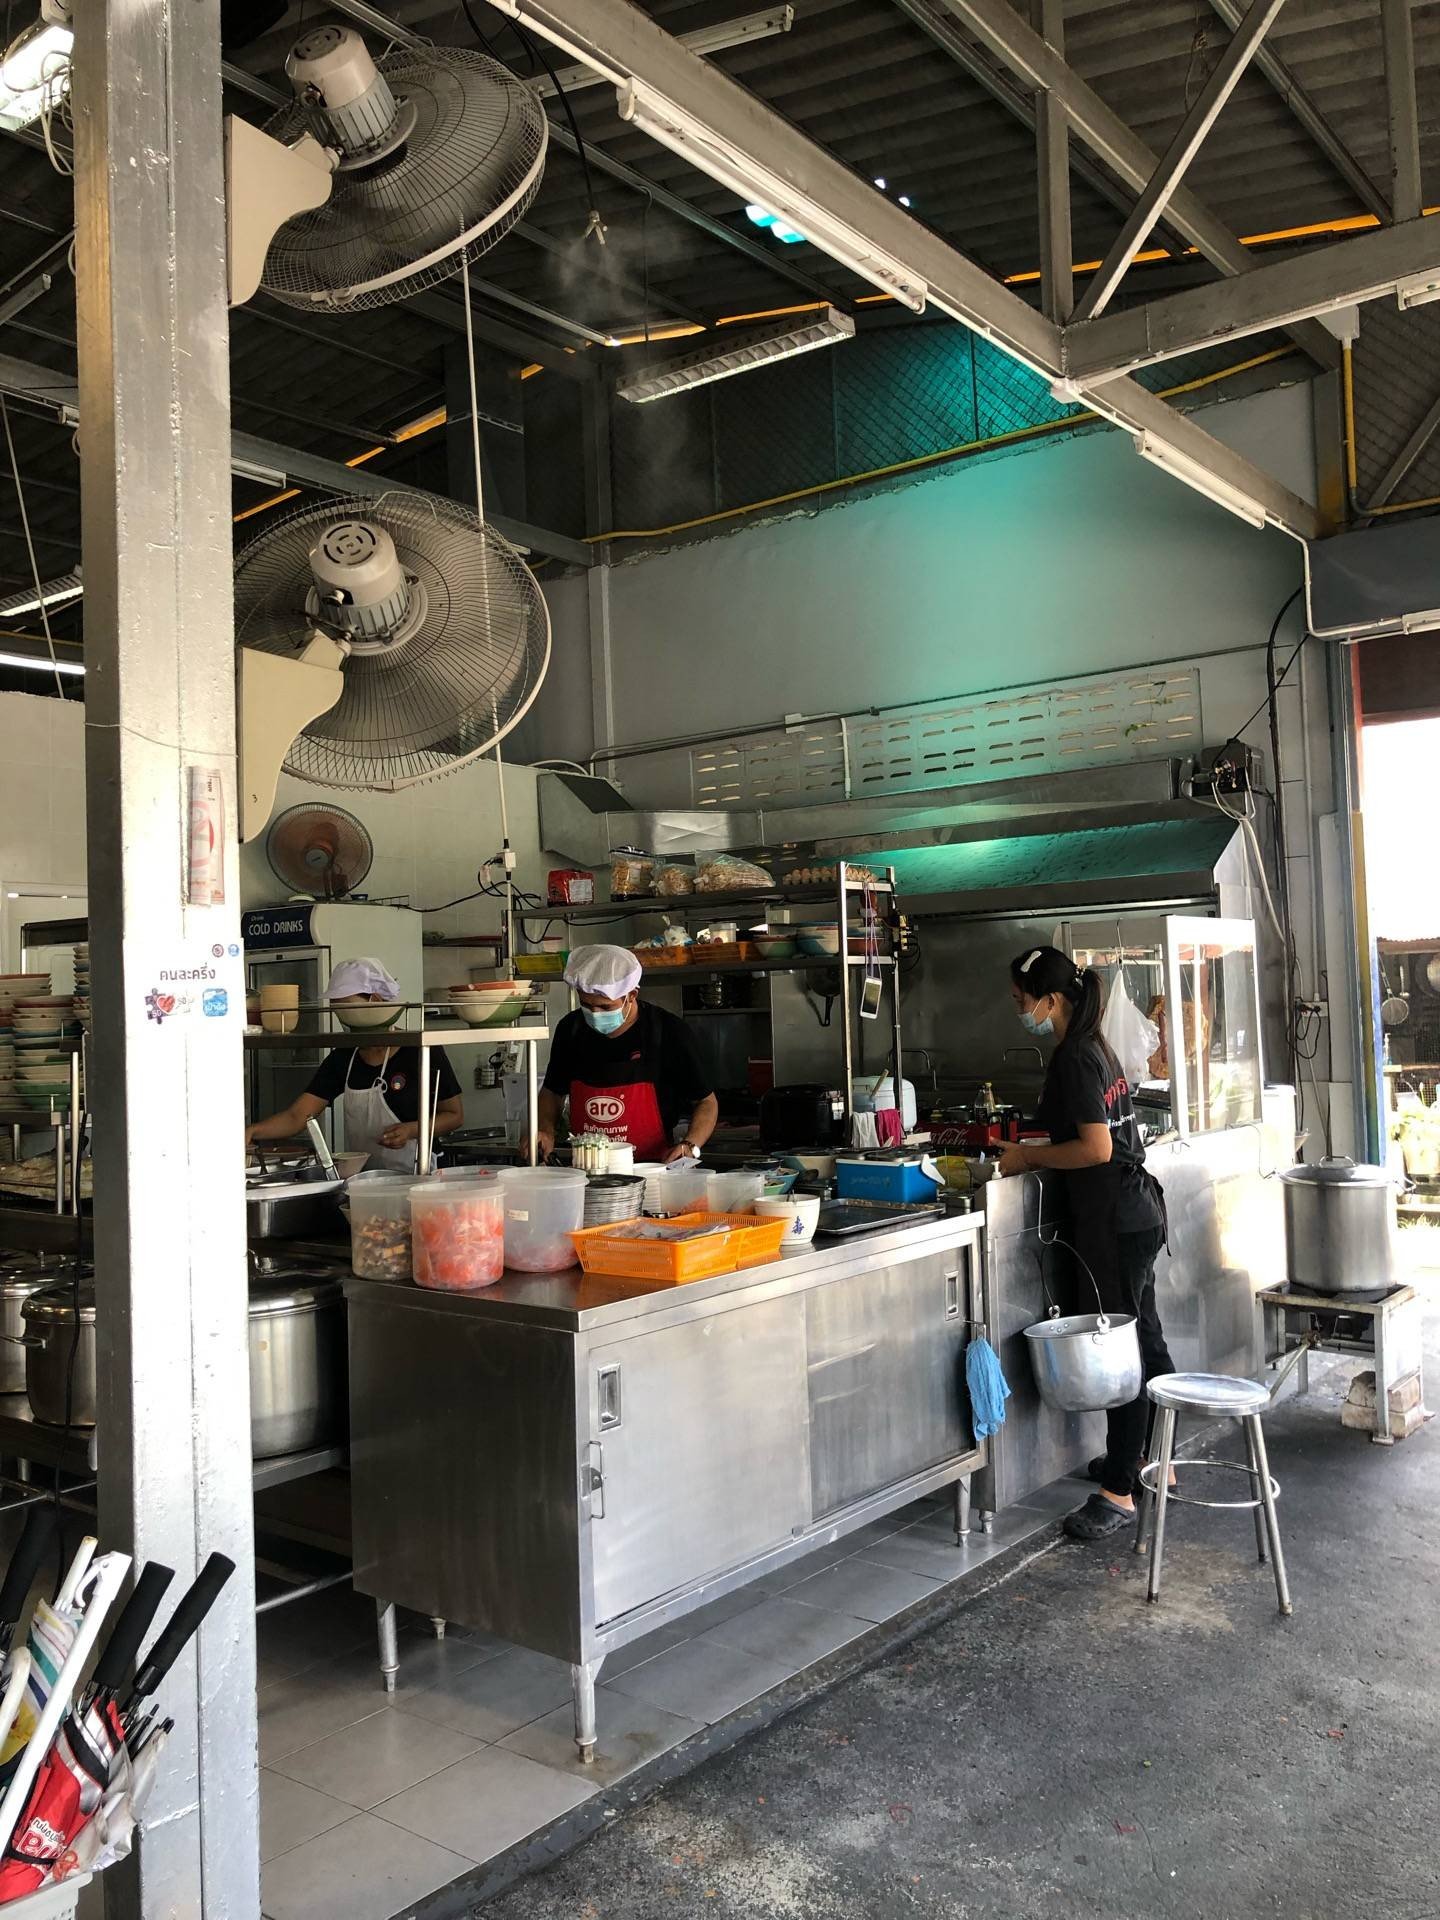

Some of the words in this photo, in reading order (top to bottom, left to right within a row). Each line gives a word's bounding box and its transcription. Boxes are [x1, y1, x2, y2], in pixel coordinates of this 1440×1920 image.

[248, 923, 270, 935] COLD
[273, 920, 303, 933] DRINKS
[160, 962, 216, 981] คนละครึ่ง
[590, 1102, 619, 1116] aro
